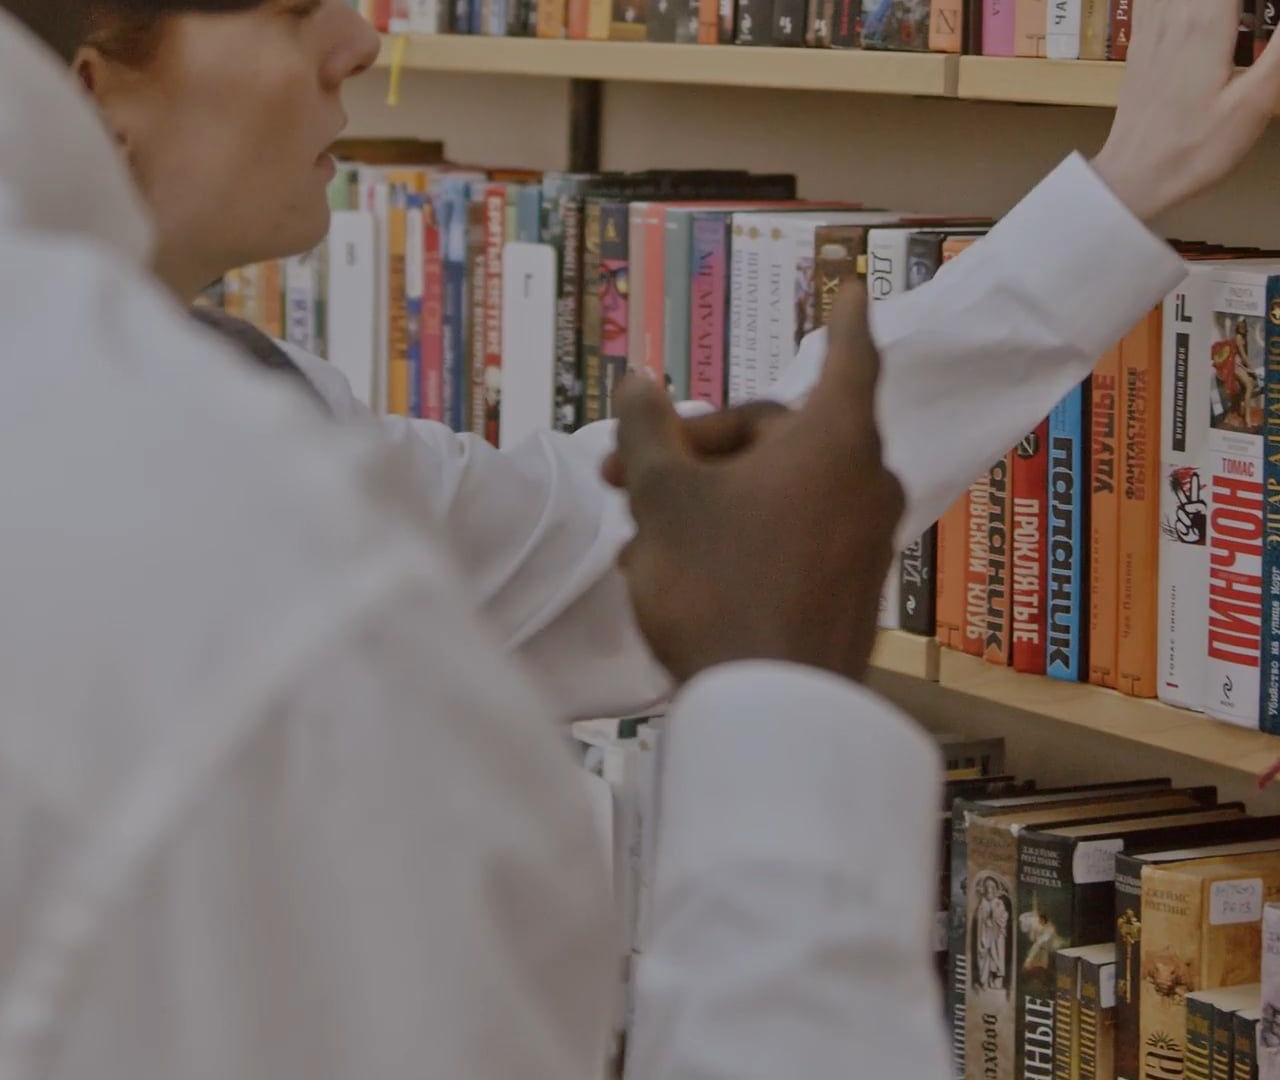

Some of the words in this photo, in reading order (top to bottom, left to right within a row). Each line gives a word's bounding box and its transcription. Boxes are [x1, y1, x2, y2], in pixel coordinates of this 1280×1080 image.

[1092, 374, 1116, 494] УДУШЬЕ
[1125, 366, 1138, 500] ФАНТАСТИЧНЕЕ
[1135, 368, 1148, 501] ВЫМЫСЛА
[1175, 379, 1186, 440] ВНУТРЕННИЙ
[1221, 457, 1256, 479] ТОМАС
[1012, 497, 1040, 644] ПРОКЛЯТЫЕ
[1049, 435, 1074, 671] паланик
[1168, 584, 1178, 630] ПИНЧОН
[1208, 474, 1264, 667] ПИНЧОН
[1167, 634, 1178, 677] ТОМАС
[1268, 640, 1280, 654] на
